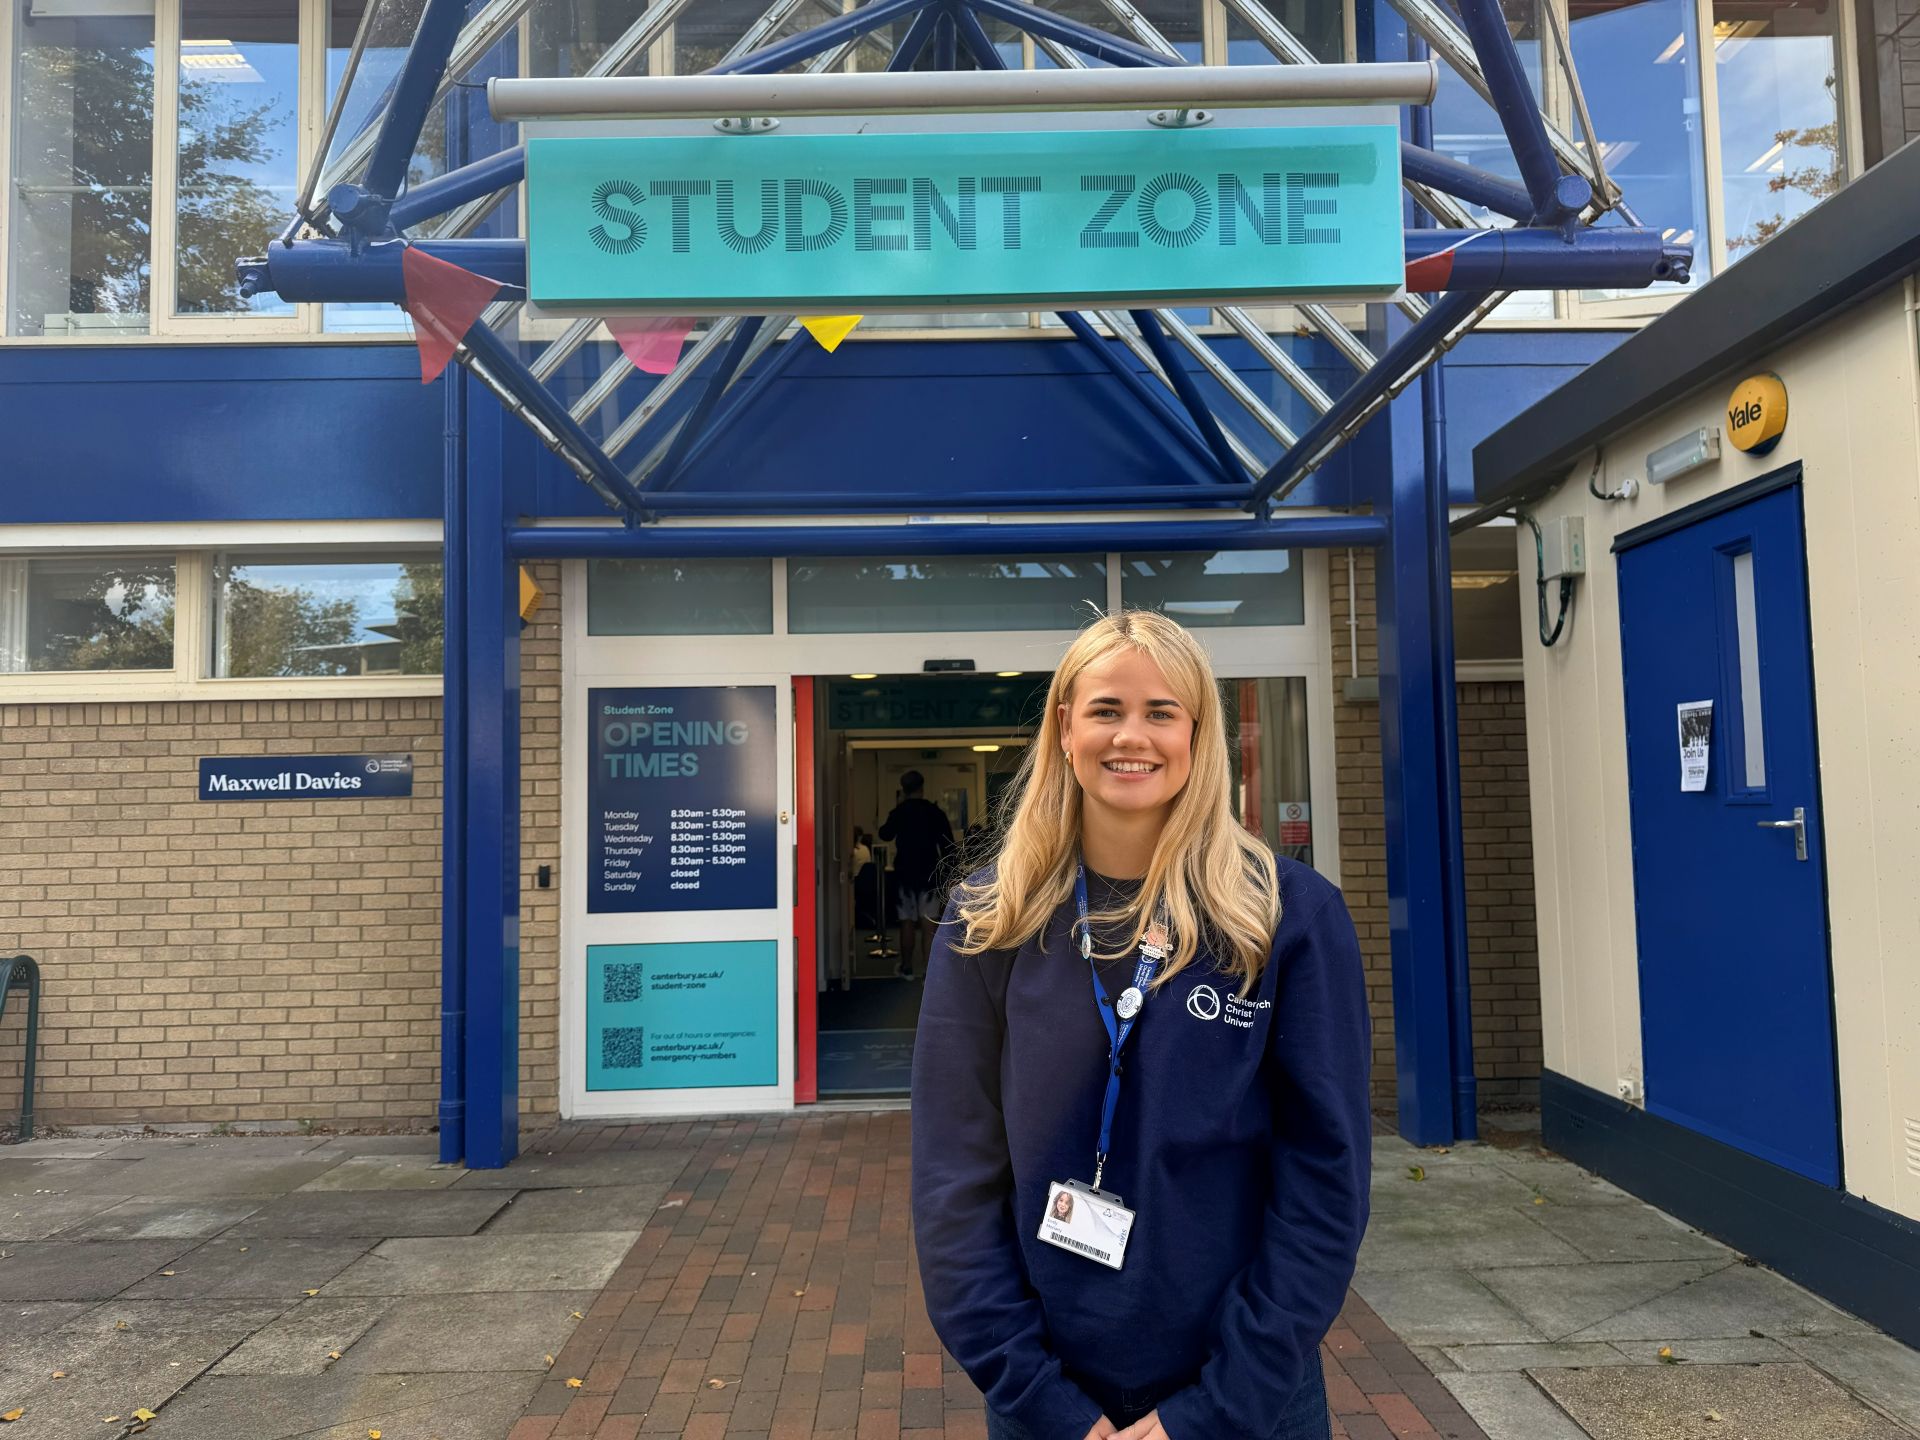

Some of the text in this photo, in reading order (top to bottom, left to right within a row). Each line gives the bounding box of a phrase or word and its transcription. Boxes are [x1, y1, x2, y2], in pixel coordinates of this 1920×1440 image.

[588, 172, 1342, 255] STUDENT ZONE
[1728, 401, 1762, 431] Yale
[604, 705, 674, 715] Student Zone
[604, 721, 749, 746] OPENING
[604, 753, 699, 778] TIMES
[208, 771, 362, 792] Maxwell Davies
[604, 811, 639, 820] Monday
[670, 809, 704, 817] 8.30am
[712, 808, 746, 818] 5.30pm
[604, 823, 639, 832] Tuesday
[712, 821, 746, 830] 5.30pm
[604, 835, 653, 844] Wednesday
[712, 832, 746, 841] 5.30pm
[604, 847, 643, 855] Thursday
[670, 845, 704, 853] 8.30am
[712, 844, 746, 853] 5.30pm
[604, 859, 630, 868] Friday
[670, 857, 704, 865] 8.30am
[712, 856, 746, 865] 5.30pm
[604, 869, 700, 880] Saturday closed
[604, 881, 700, 892] Sunday closed
[651, 971, 724, 981] canterbury.ac.uk/
[651, 981, 706, 990] student-zone
[1225, 1004, 1252, 1018] Christ
[1224, 1015, 1254, 1028] Univer
[651, 1041, 724, 1052] canterbury.ac.uk/
[651, 1051, 737, 1062] emergency-numbers
